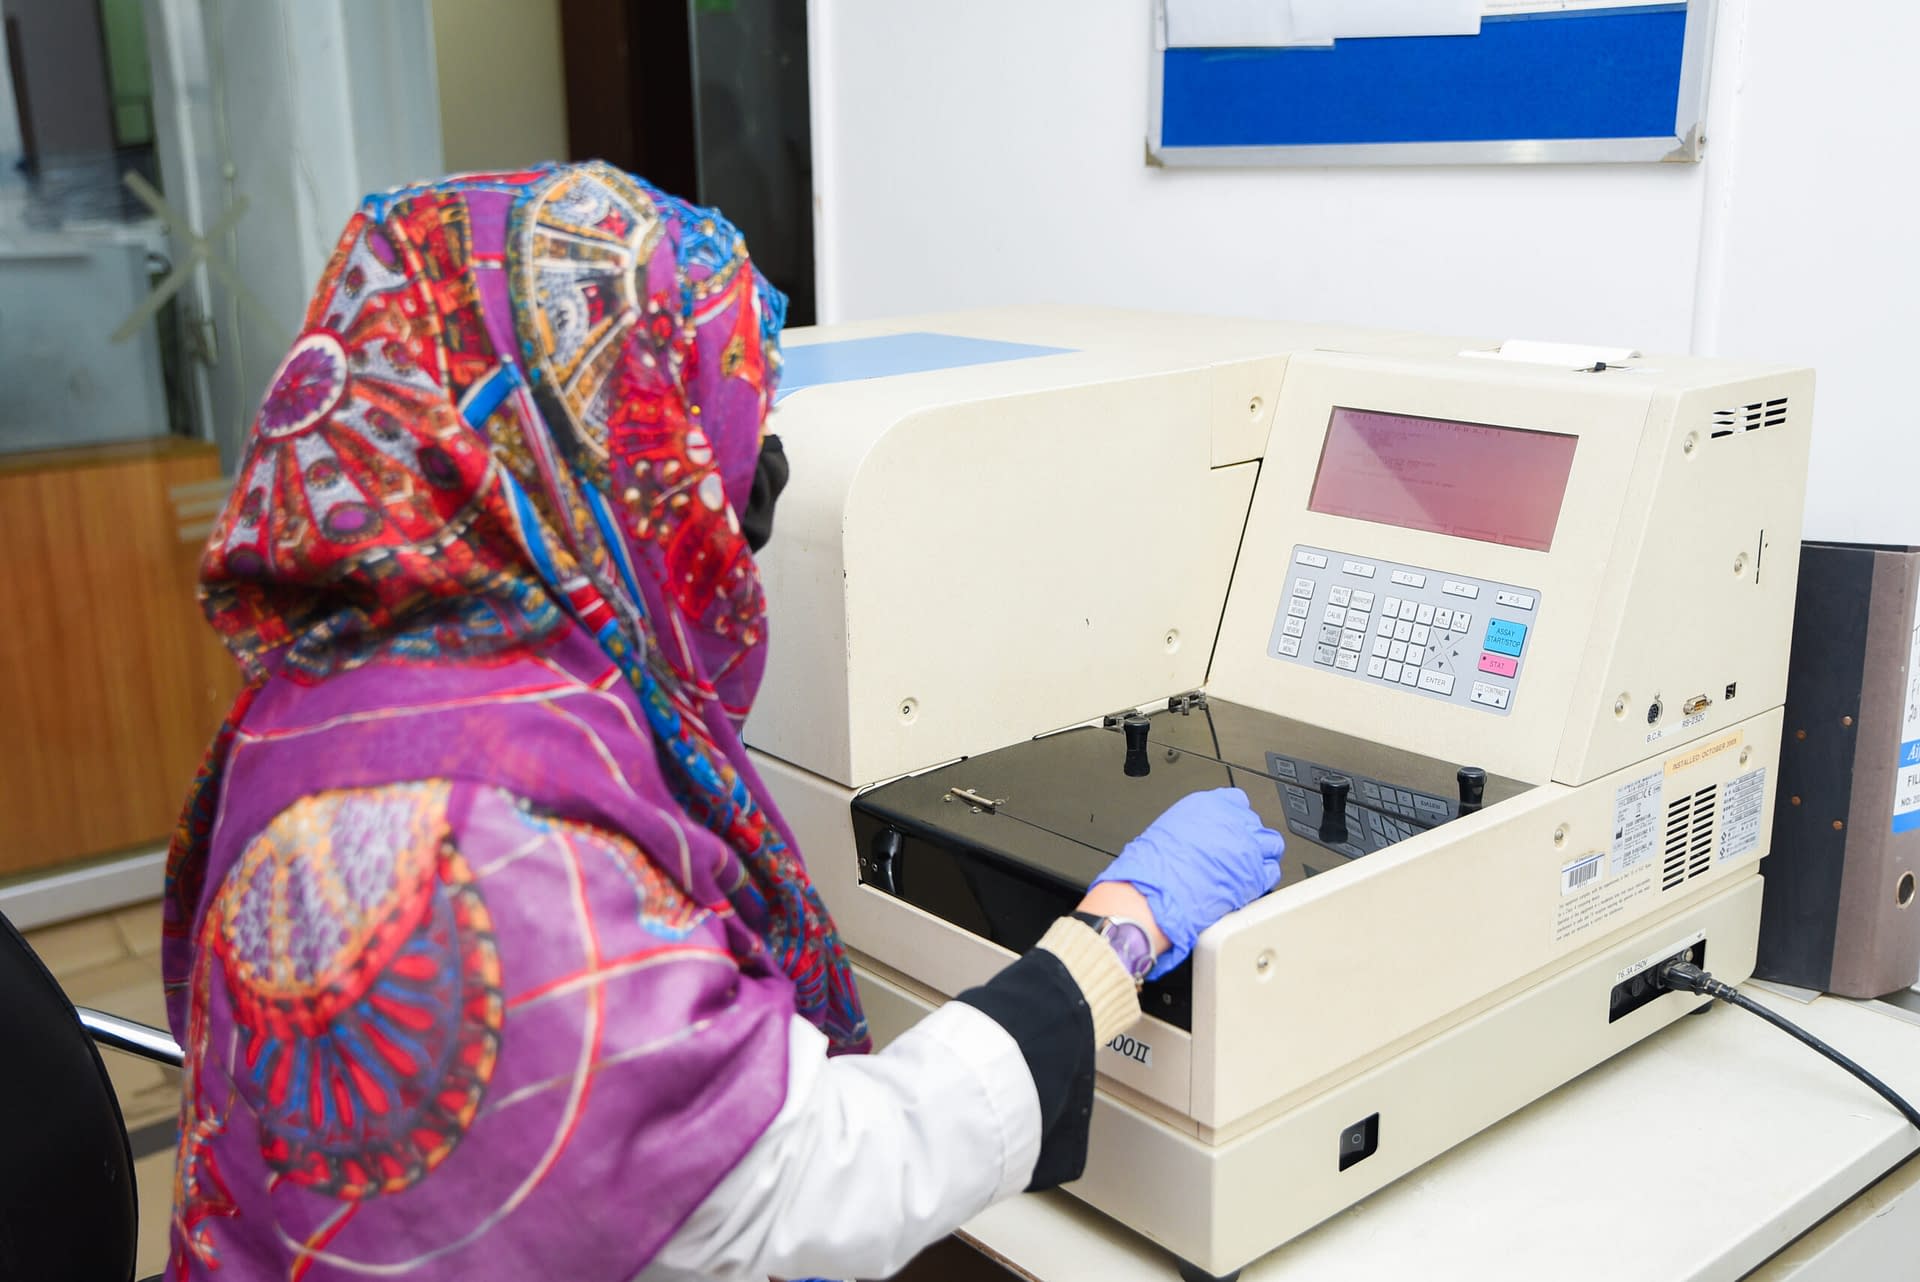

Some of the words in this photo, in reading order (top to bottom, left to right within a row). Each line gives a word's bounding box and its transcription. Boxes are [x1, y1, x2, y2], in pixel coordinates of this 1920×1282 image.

[1435, 617, 1448, 626] ROLL
[1453, 621, 1466, 630] ROLL
[1496, 628, 1516, 637] ASSAY
[1487, 635, 1521, 648] START/STOP
[1489, 661, 1505, 669] STAT
[1426, 676, 1446, 687] ENTER
[1682, 713, 1705, 727] RS-232C
[1702, 743, 1725, 758] OCTOBER
[1907, 773, 1920, 787] FIL
